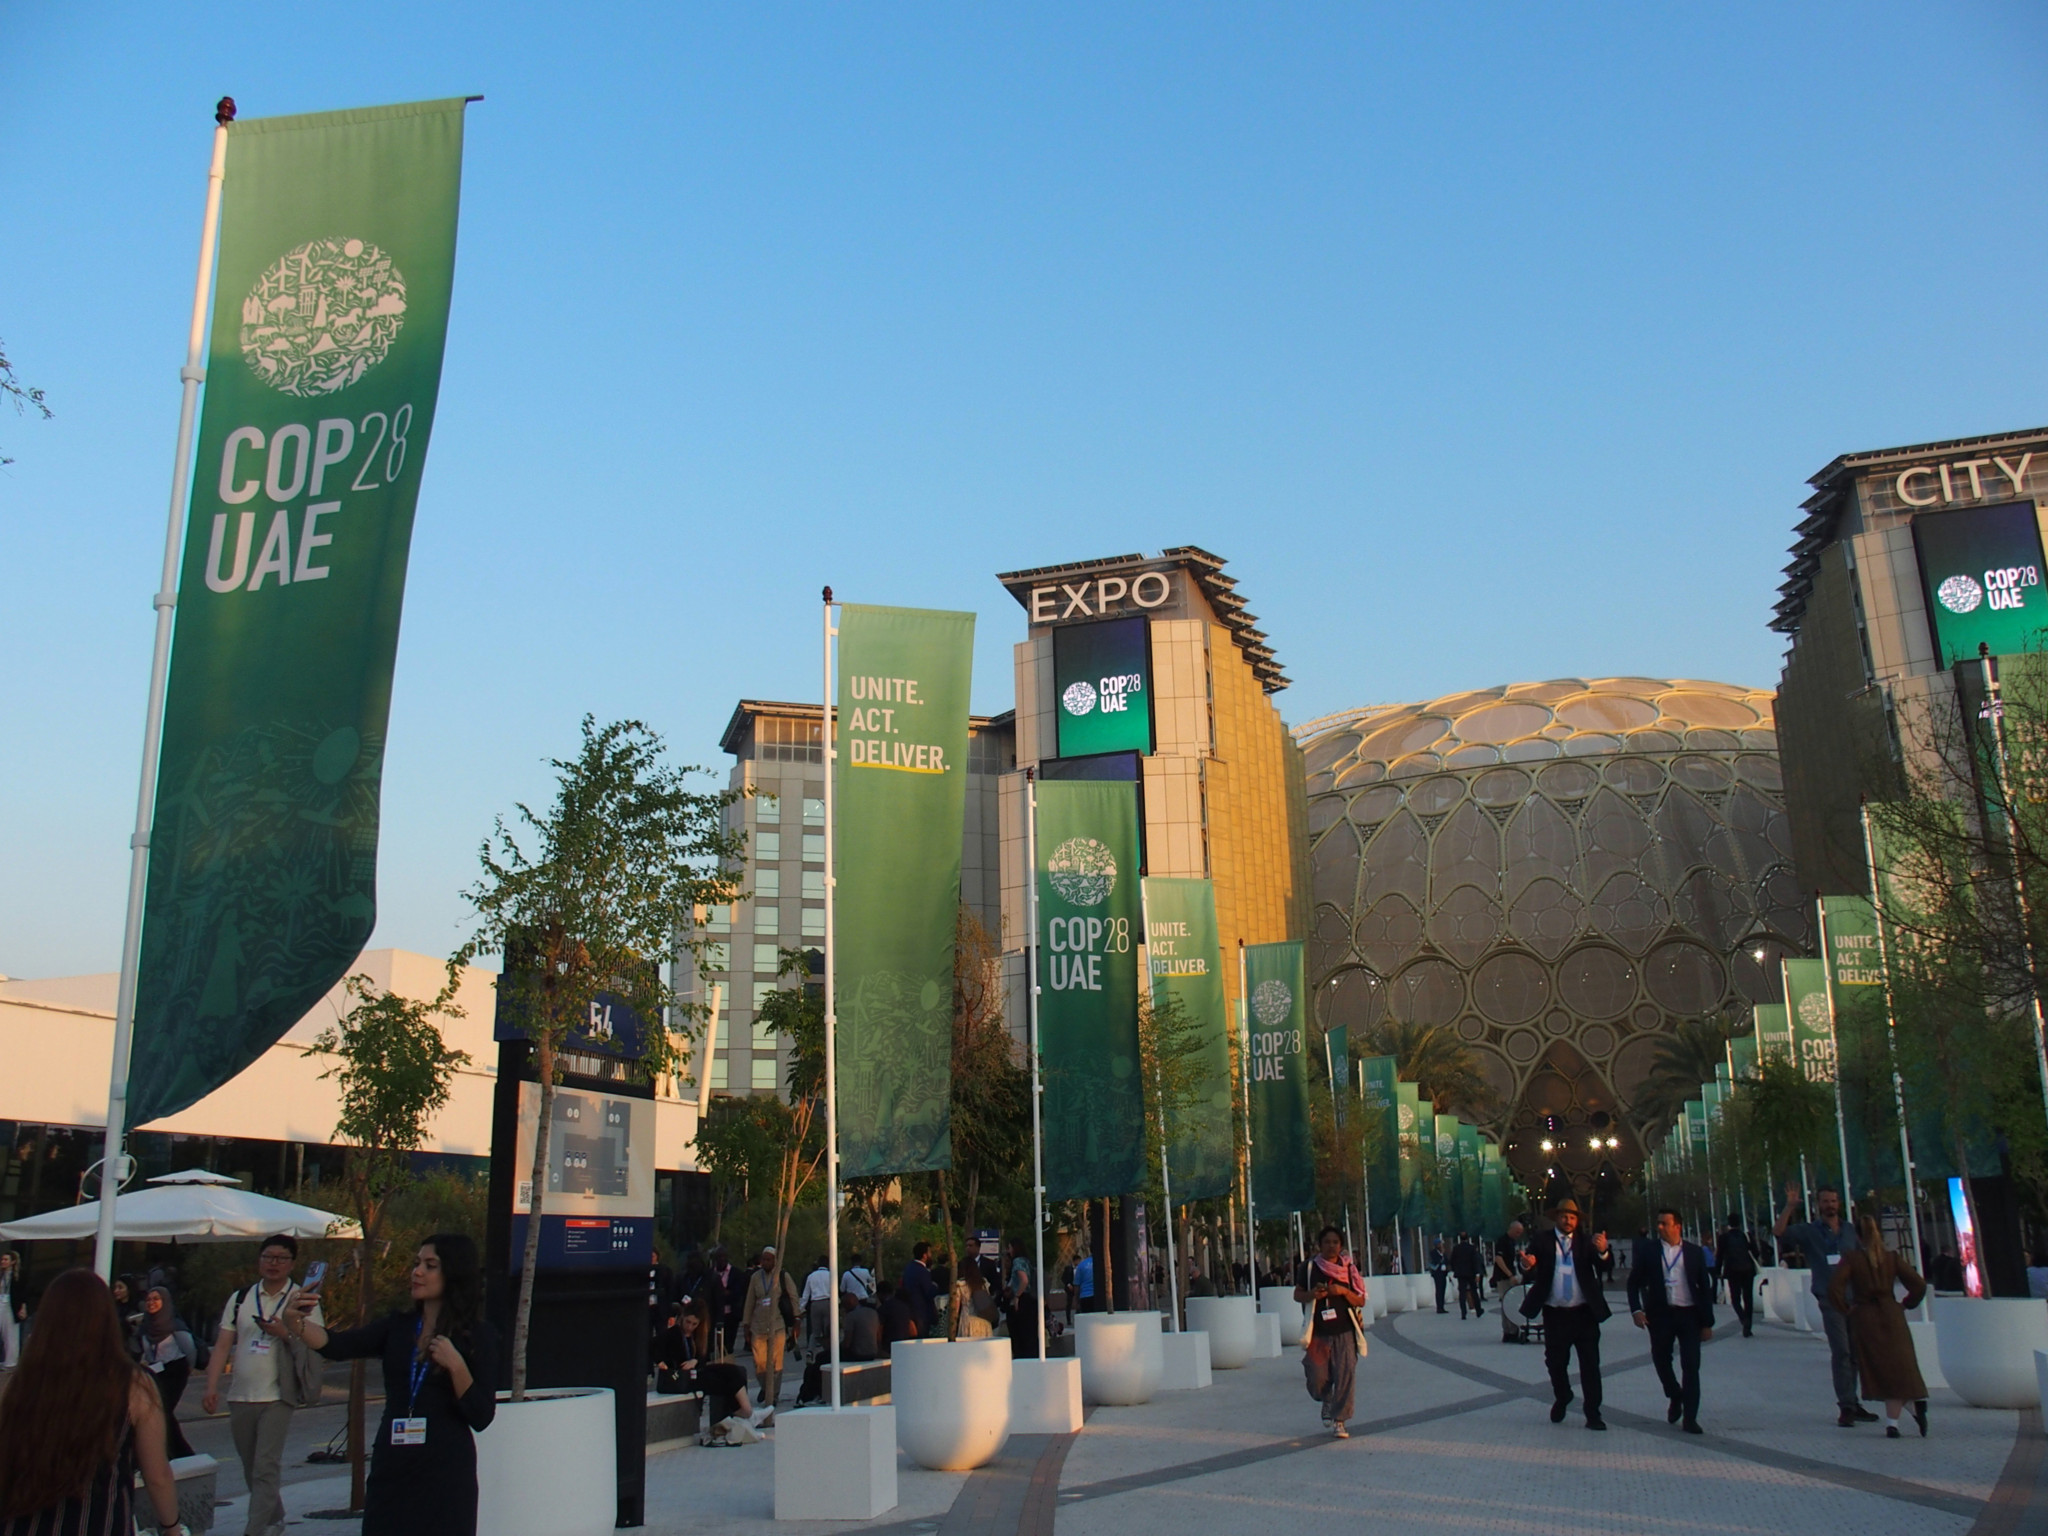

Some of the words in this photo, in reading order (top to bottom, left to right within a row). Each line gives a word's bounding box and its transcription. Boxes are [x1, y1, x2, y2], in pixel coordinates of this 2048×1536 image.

[219, 404, 412, 504] COP28
[1896, 453, 2032, 506] CITY
[205, 501, 341, 593] UAE
[1984, 566, 2037, 590] COP28
[1032, 572, 1170, 622] EXPO
[1987, 588, 2024, 610] UAE
[851, 676, 924, 705] UNITE.
[1100, 674, 1141, 695] COP28
[1101, 693, 1127, 713] UAE
[849, 707, 899, 734] ACT.
[850, 739, 950, 772] DELIVER.
[1050, 917, 1130, 953] COP28
[1151, 922, 1191, 937] UNITE.
[1152, 941, 1178, 956] ACT.
[1050, 954, 1102, 991] UAE
[1153, 959, 1210, 974] DELIVER.
[1838, 969, 1882, 983] DELIVE
[589, 1001, 613, 1040] B4
[1252, 1029, 1301, 1056] COP28
[1252, 1057, 1285, 1081] UAE
